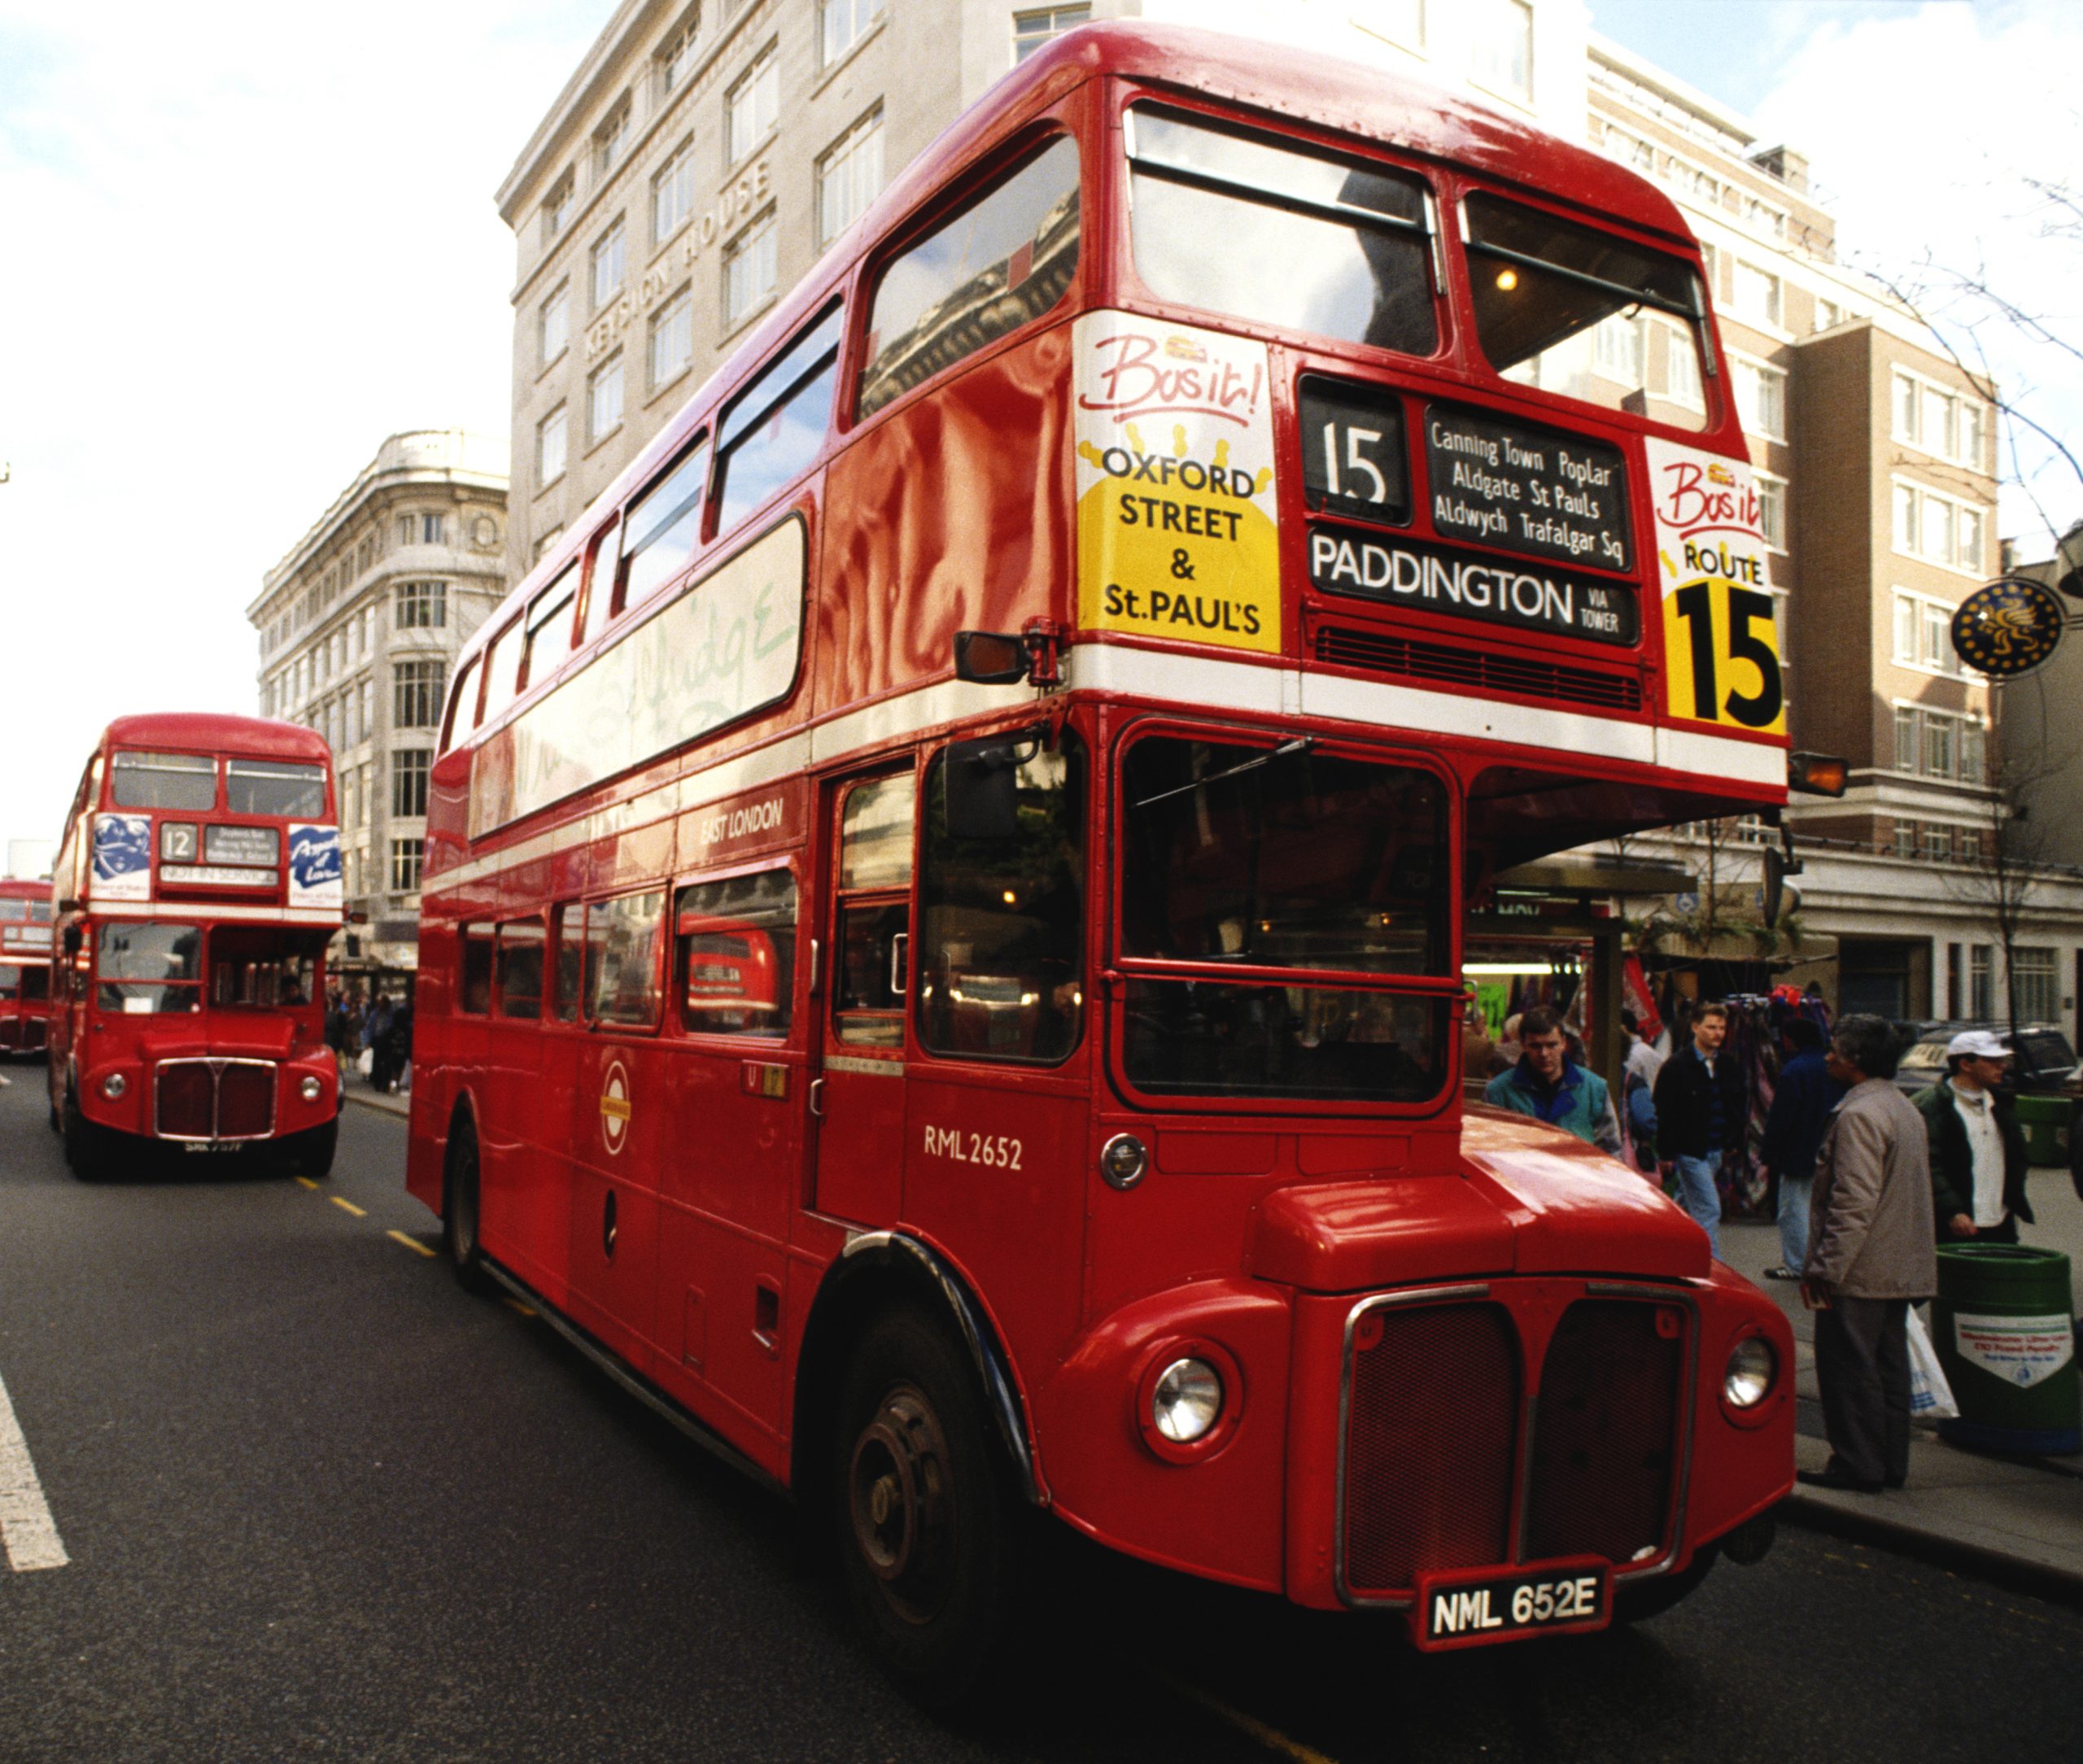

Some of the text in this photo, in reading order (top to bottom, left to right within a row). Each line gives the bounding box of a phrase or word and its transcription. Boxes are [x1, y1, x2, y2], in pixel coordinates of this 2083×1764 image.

[1102, 446, 1255, 500] OXFORD
[1323, 421, 1386, 504] 15
[1430, 421, 1612, 489] Canning Town Poplar
[1119, 492, 1243, 542] STREET
[1452, 461, 1600, 520] Aldgate St Pauls
[1434, 495, 1624, 567] Aldwych Trafalgar Sq
[1169, 548, 1196, 581] &
[1311, 533, 1574, 625] PADDINGTON
[1683, 544, 1763, 587] ROUTE
[1579, 608, 1620, 634] TOWER
[1587, 587, 1609, 609] VIA
[1675, 580, 1784, 728] 15
[166, 830, 190, 858] 12
[701, 797, 784, 845] EAST LONDON
[1433, 1576, 1597, 1635] NML 652E
